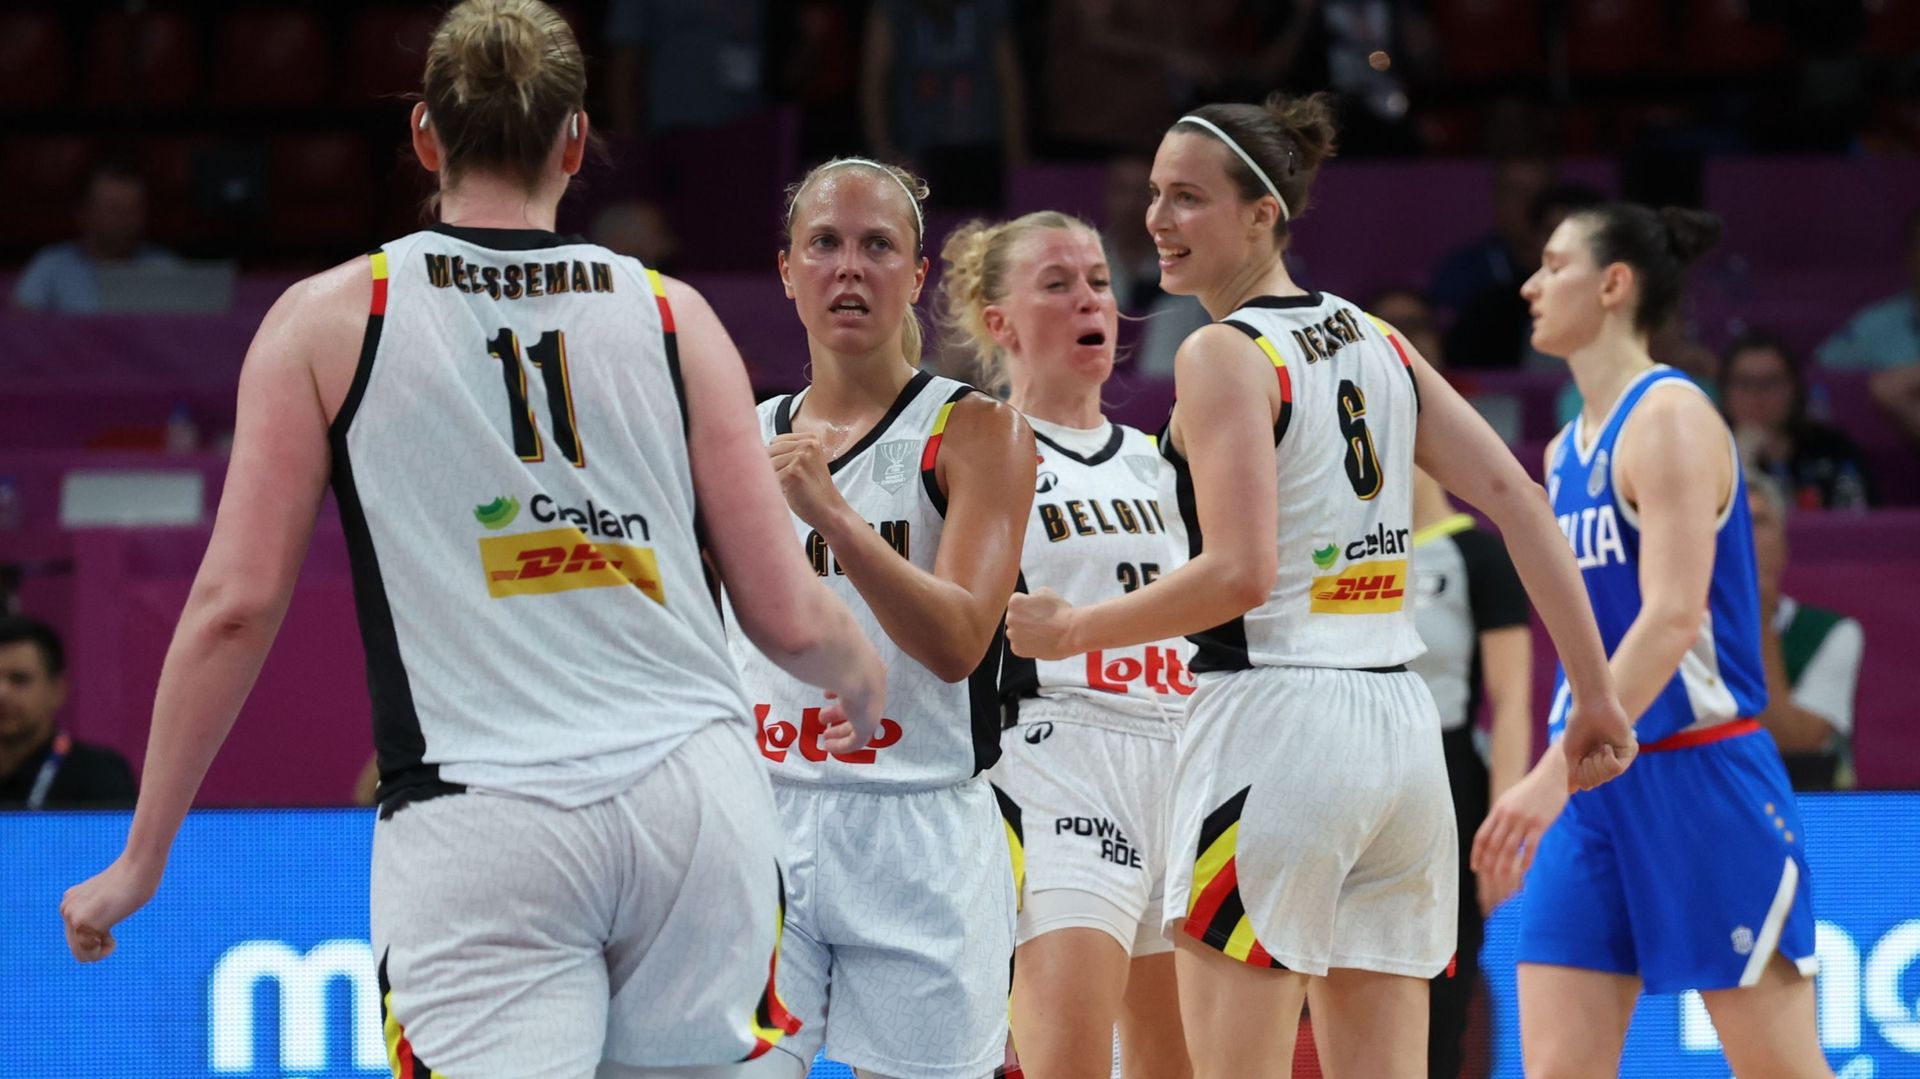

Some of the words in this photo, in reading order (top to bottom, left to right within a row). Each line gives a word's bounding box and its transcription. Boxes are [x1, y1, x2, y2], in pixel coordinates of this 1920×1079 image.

[486, 326, 586, 468] 11
[1336, 378, 1384, 501] 6
[1330, 574, 1404, 601] DHL
[1086, 646, 1197, 696] Lott
[753, 703, 903, 764] Loto
[1101, 839, 1143, 871] ADE
